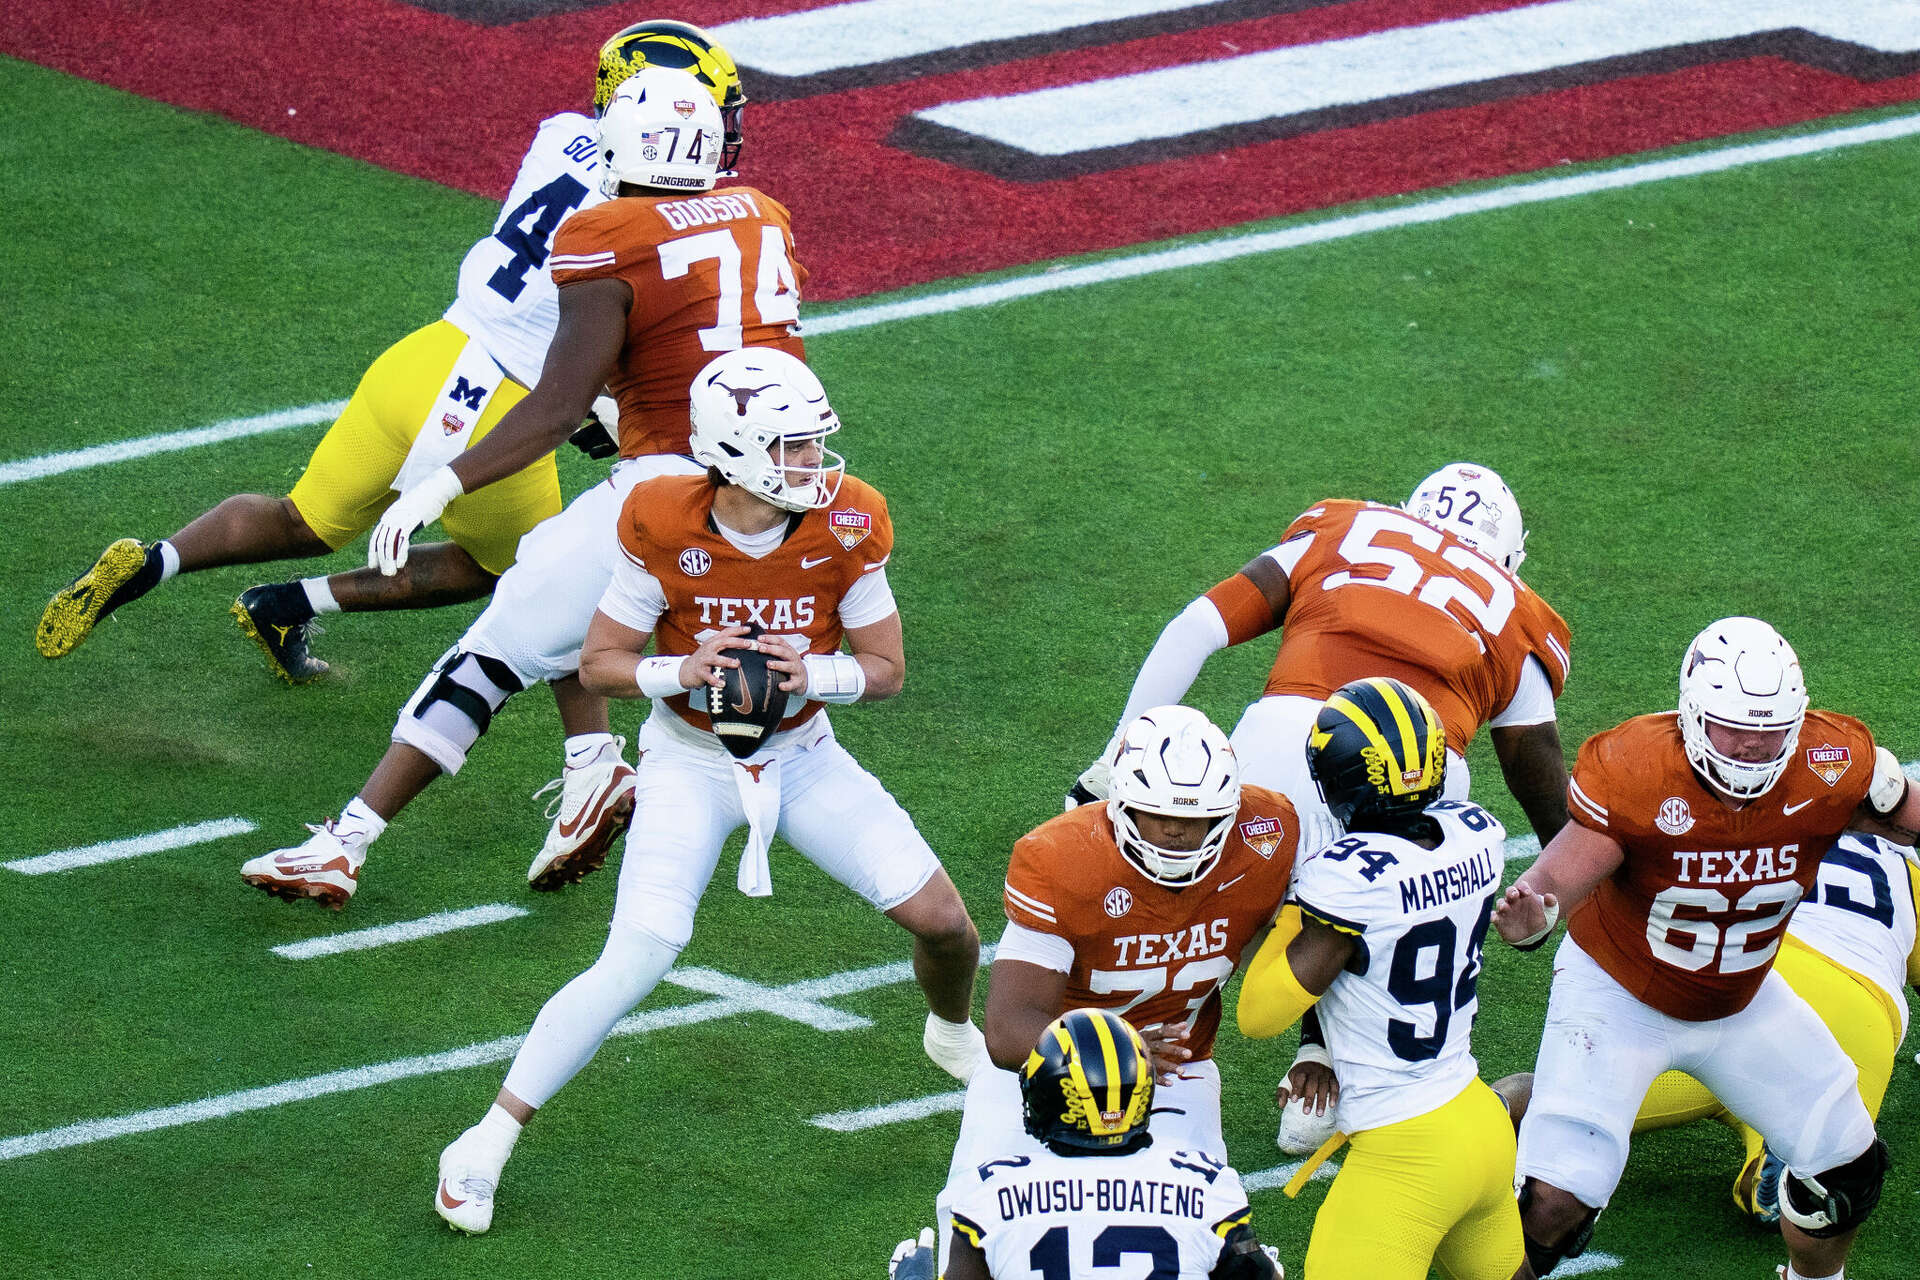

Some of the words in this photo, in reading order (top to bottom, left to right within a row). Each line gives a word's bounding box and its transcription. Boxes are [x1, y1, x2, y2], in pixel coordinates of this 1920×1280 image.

[563, 135, 597, 171] GU
[664, 127, 703, 164] 74
[650, 174, 706, 188] LONGHORNS
[655, 193, 761, 231] GOOSBY
[486, 172, 591, 303] 4
[656, 224, 801, 352] 74
[449, 376, 488, 411] M
[835, 514, 867, 527] CHEEZ-IT
[1435, 486, 1481, 526] 52
[680, 551, 710, 574] SEC
[1321, 509, 1516, 655] 52
[694, 595, 816, 630] TEXAS
[1748, 709, 1773, 718] HORNS
[1812, 750, 1844, 762] CHEEZ-IT
[1172, 796, 1199, 806] HORNS
[1377, 784, 1390, 795] 94
[1246, 821, 1276, 836] CHEEZ-IT
[1661, 799, 1688, 826] SEC
[1323, 838, 1400, 883] 94
[1672, 844, 1799, 884] TEXAS
[1399, 848, 1496, 914] MARSHALL
[1106, 888, 1131, 917] SEC
[1113, 918, 1229, 967] TEXAS
[1646, 879, 1804, 974] 62
[1386, 892, 1498, 1061] 94
[998, 1179, 1205, 1222] OWUSU-BOATENG
